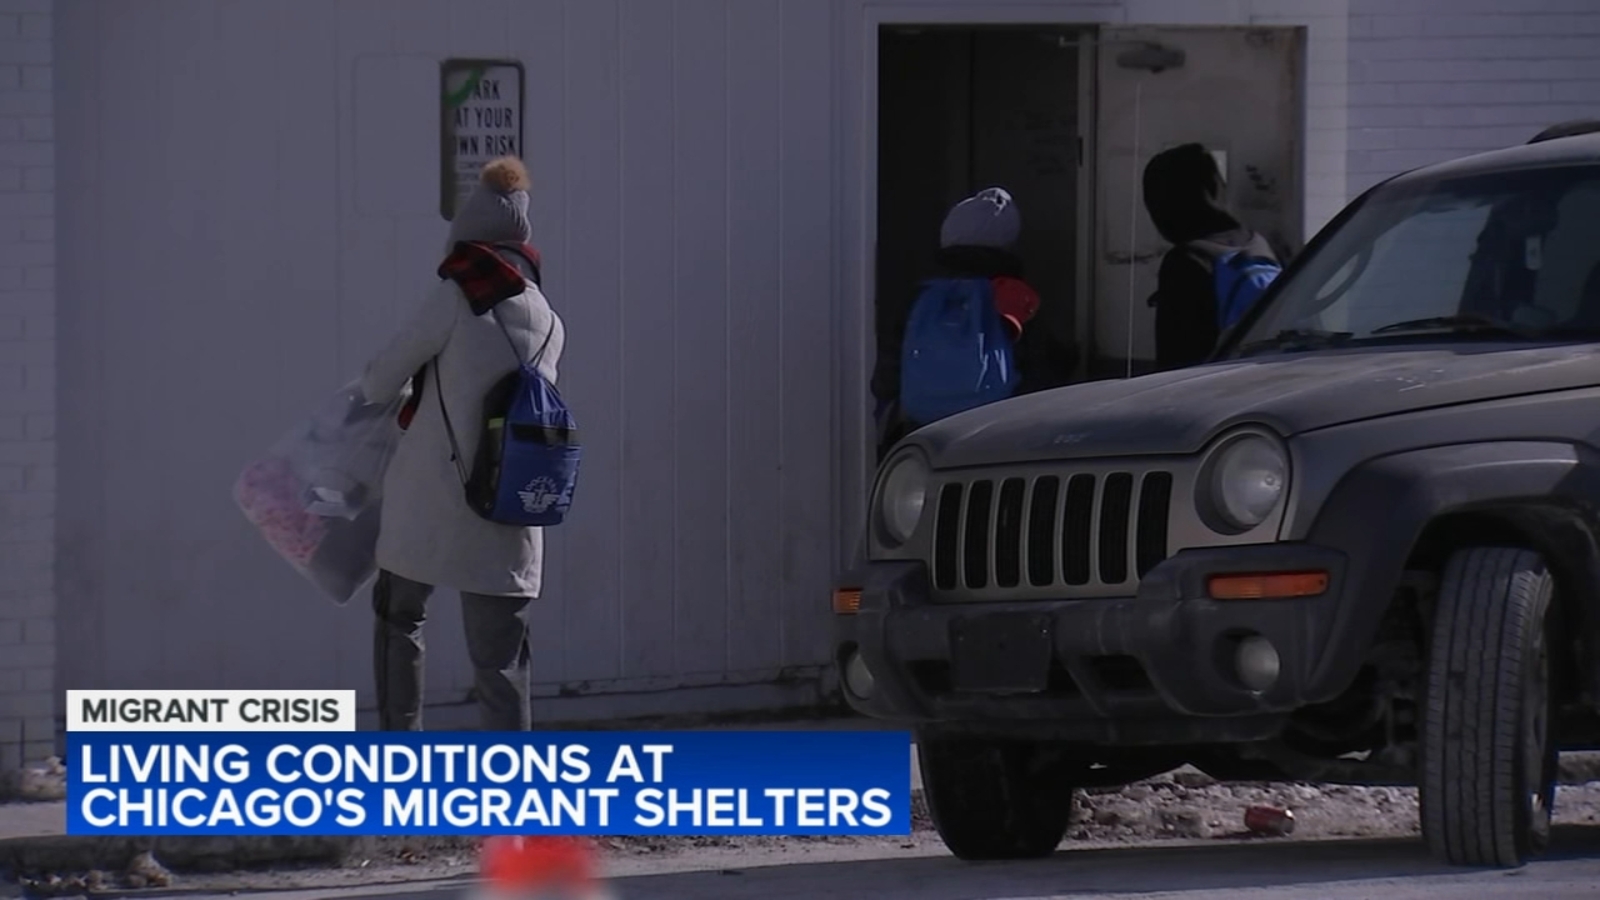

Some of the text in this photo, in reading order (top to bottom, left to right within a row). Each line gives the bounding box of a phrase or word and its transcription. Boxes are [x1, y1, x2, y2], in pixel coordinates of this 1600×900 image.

[466, 80, 500, 100] ARK
[455, 107, 513, 128] AT YOUR
[484, 135, 516, 155] RISK
